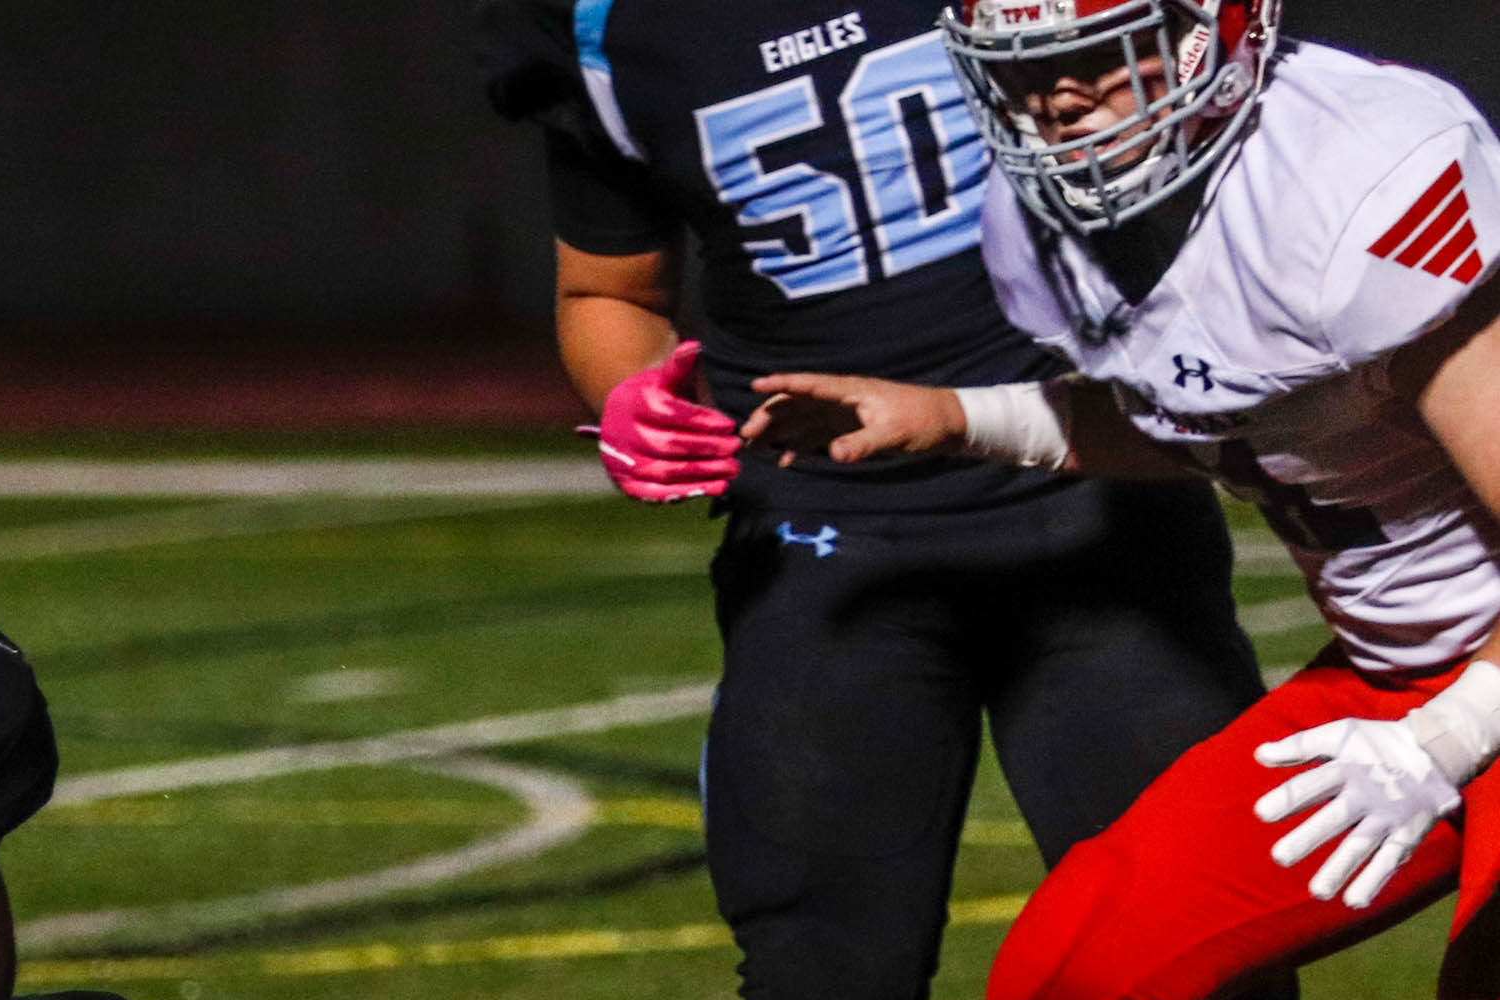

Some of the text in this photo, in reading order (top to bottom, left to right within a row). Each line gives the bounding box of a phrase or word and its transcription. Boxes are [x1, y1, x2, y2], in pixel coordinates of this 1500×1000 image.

[759, 11, 867, 73] EAGLES
[1001, 5, 1041, 25] TPW
[693, 28, 994, 299] 50
